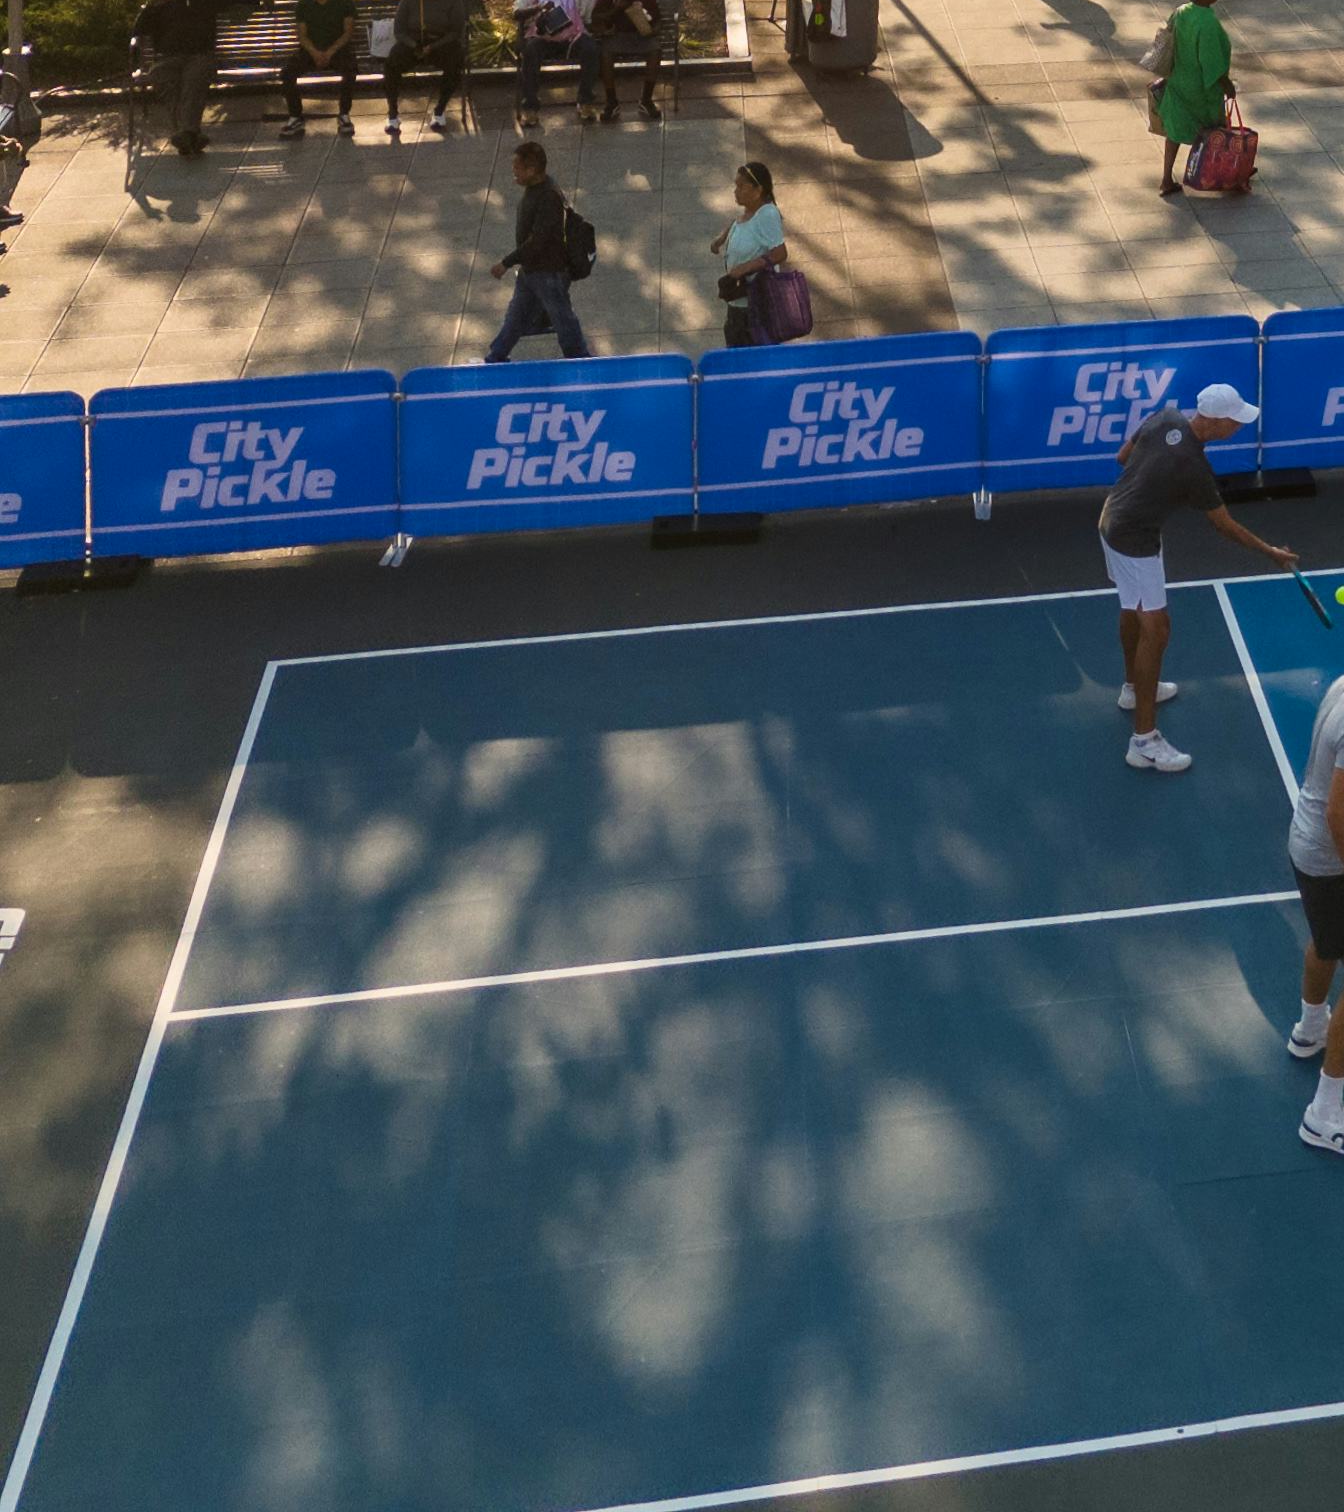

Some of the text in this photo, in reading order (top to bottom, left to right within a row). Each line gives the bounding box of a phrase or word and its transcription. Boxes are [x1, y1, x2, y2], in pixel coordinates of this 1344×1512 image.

[787, 382, 896, 430] City
[1074, 362, 1177, 406] City
[187, 420, 304, 470] City
[495, 402, 608, 452] City
[761, 418, 923, 469] Pickle
[1047, 399, 1197, 446] Pick
[160, 460, 336, 512] Pickle
[466, 441, 636, 489] Pickle
